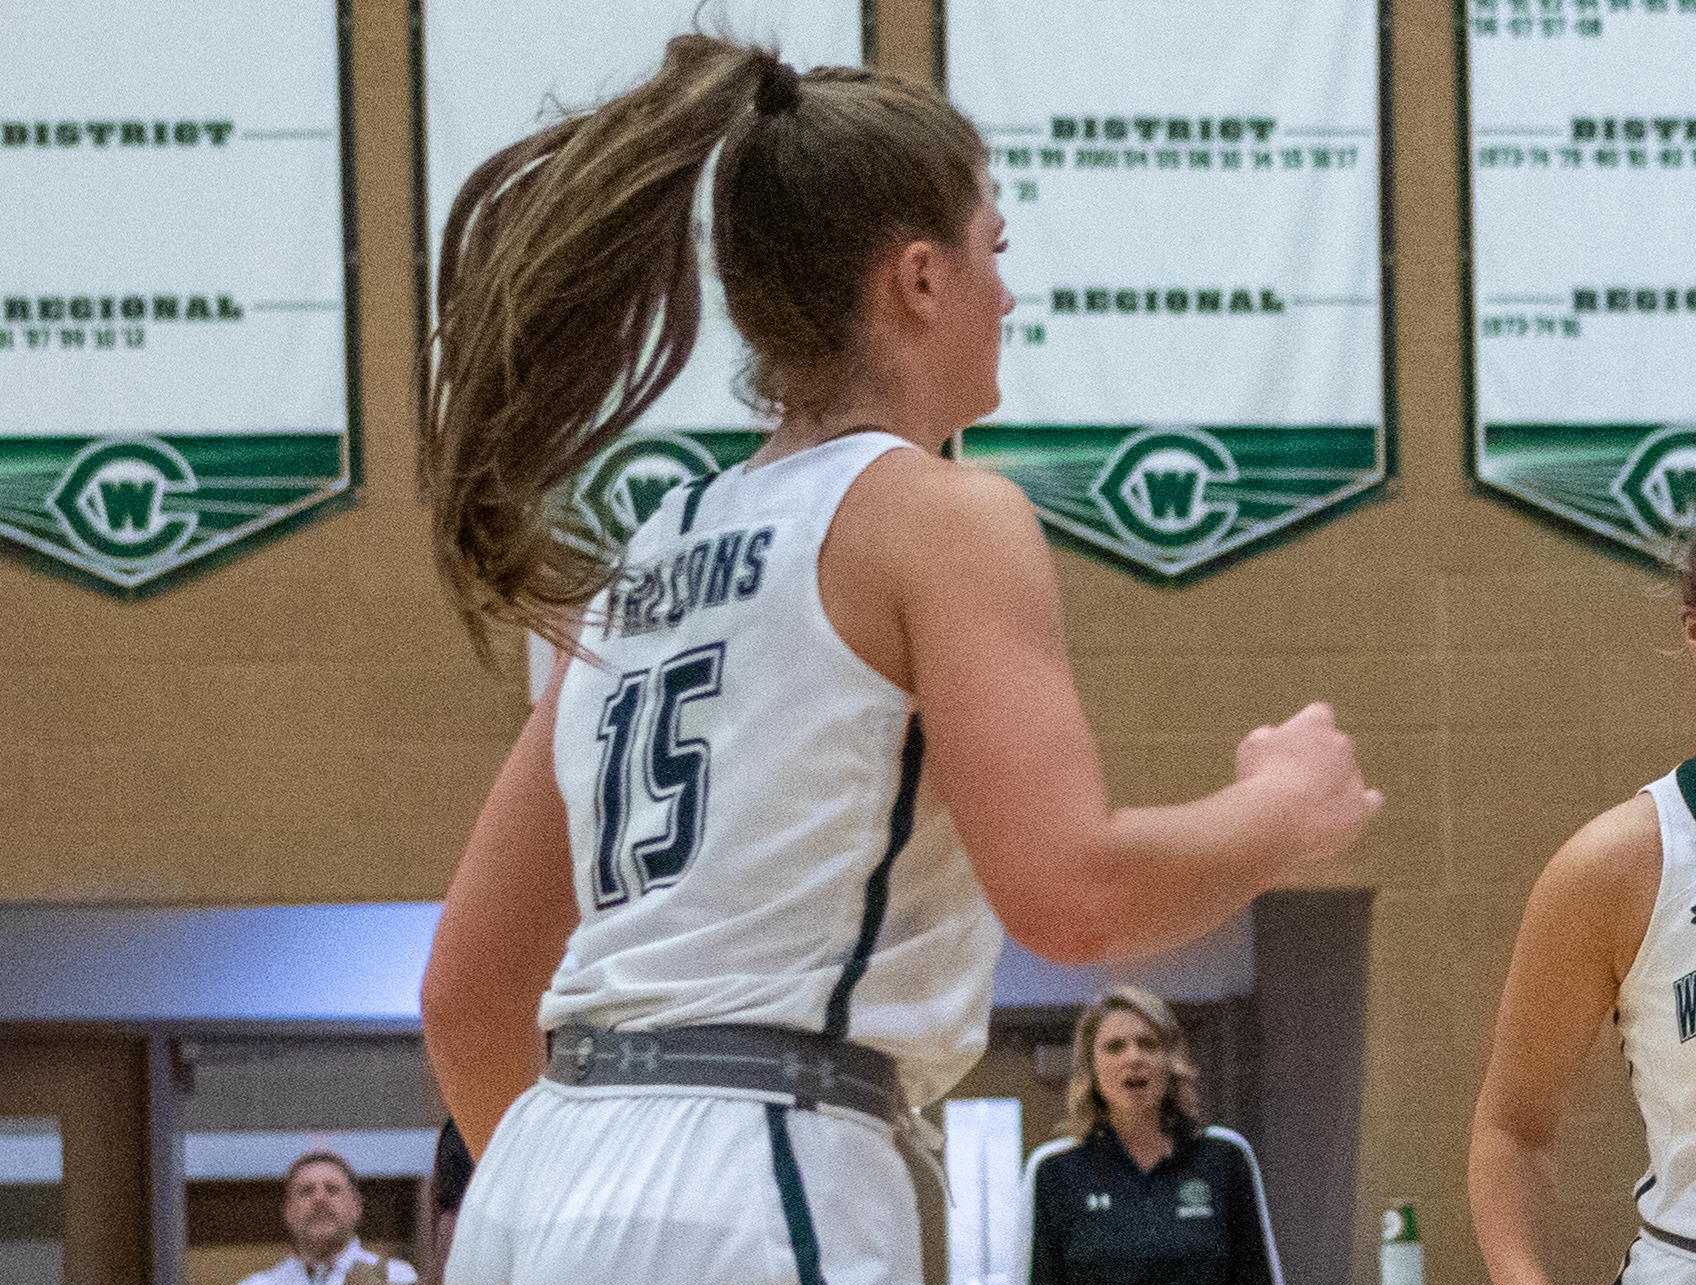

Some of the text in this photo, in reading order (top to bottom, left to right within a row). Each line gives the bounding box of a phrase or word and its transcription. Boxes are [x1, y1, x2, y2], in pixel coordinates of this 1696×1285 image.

[0, 120, 234, 148] DISTRICT
[1051, 116, 1276, 144] DISTRICT
[2, 295, 243, 324] REGIONAL
[1051, 287, 1285, 315] REGIONAL
[595, 640, 727, 911] 15
